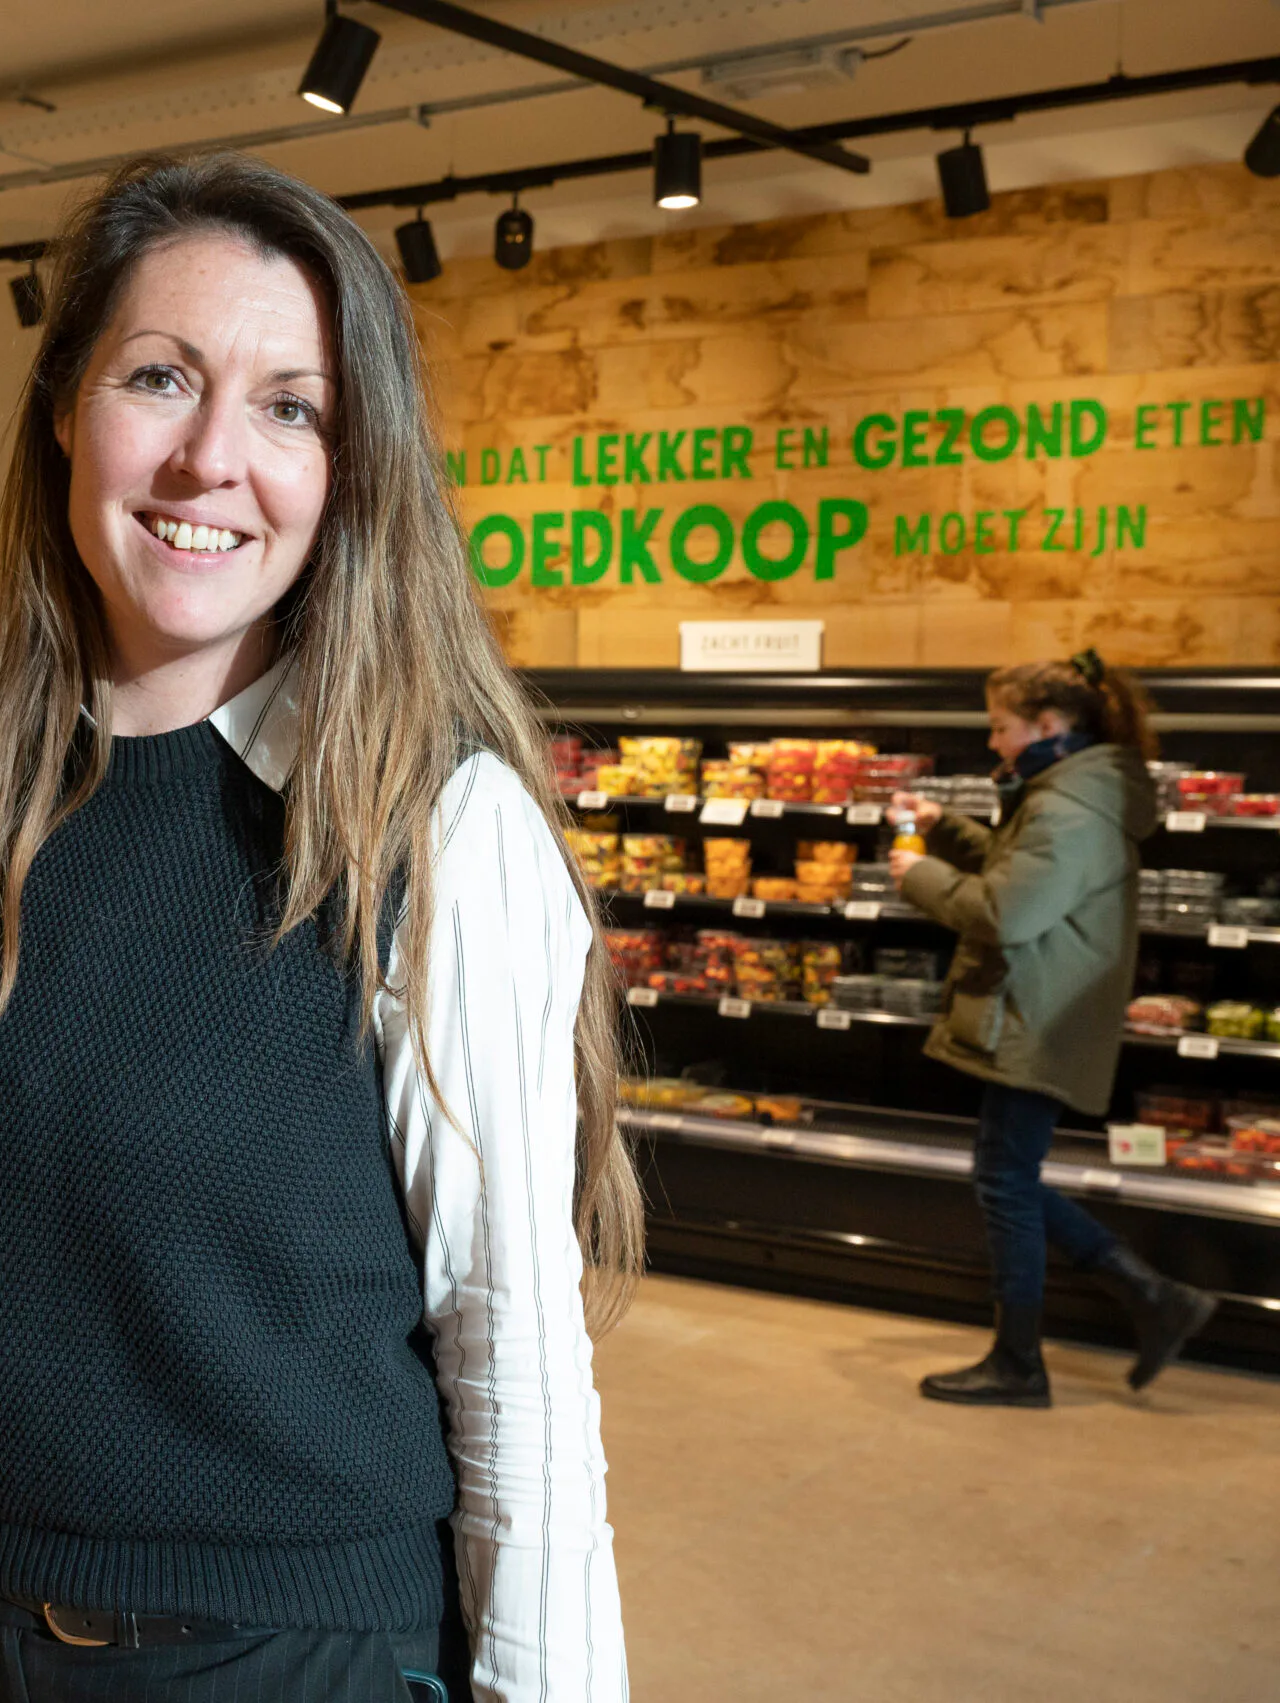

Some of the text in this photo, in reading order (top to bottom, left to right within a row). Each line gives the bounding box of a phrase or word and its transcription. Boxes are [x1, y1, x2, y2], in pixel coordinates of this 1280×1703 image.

[481, 445, 553, 485] DAT
[572, 425, 754, 487] LEKKER
[775, 427, 829, 470] EN
[853, 399, 1108, 470] GEZOND
[1134, 399, 1266, 450] ETEN
[469, 498, 1147, 588] OEDKOOP MOET ZIJN
